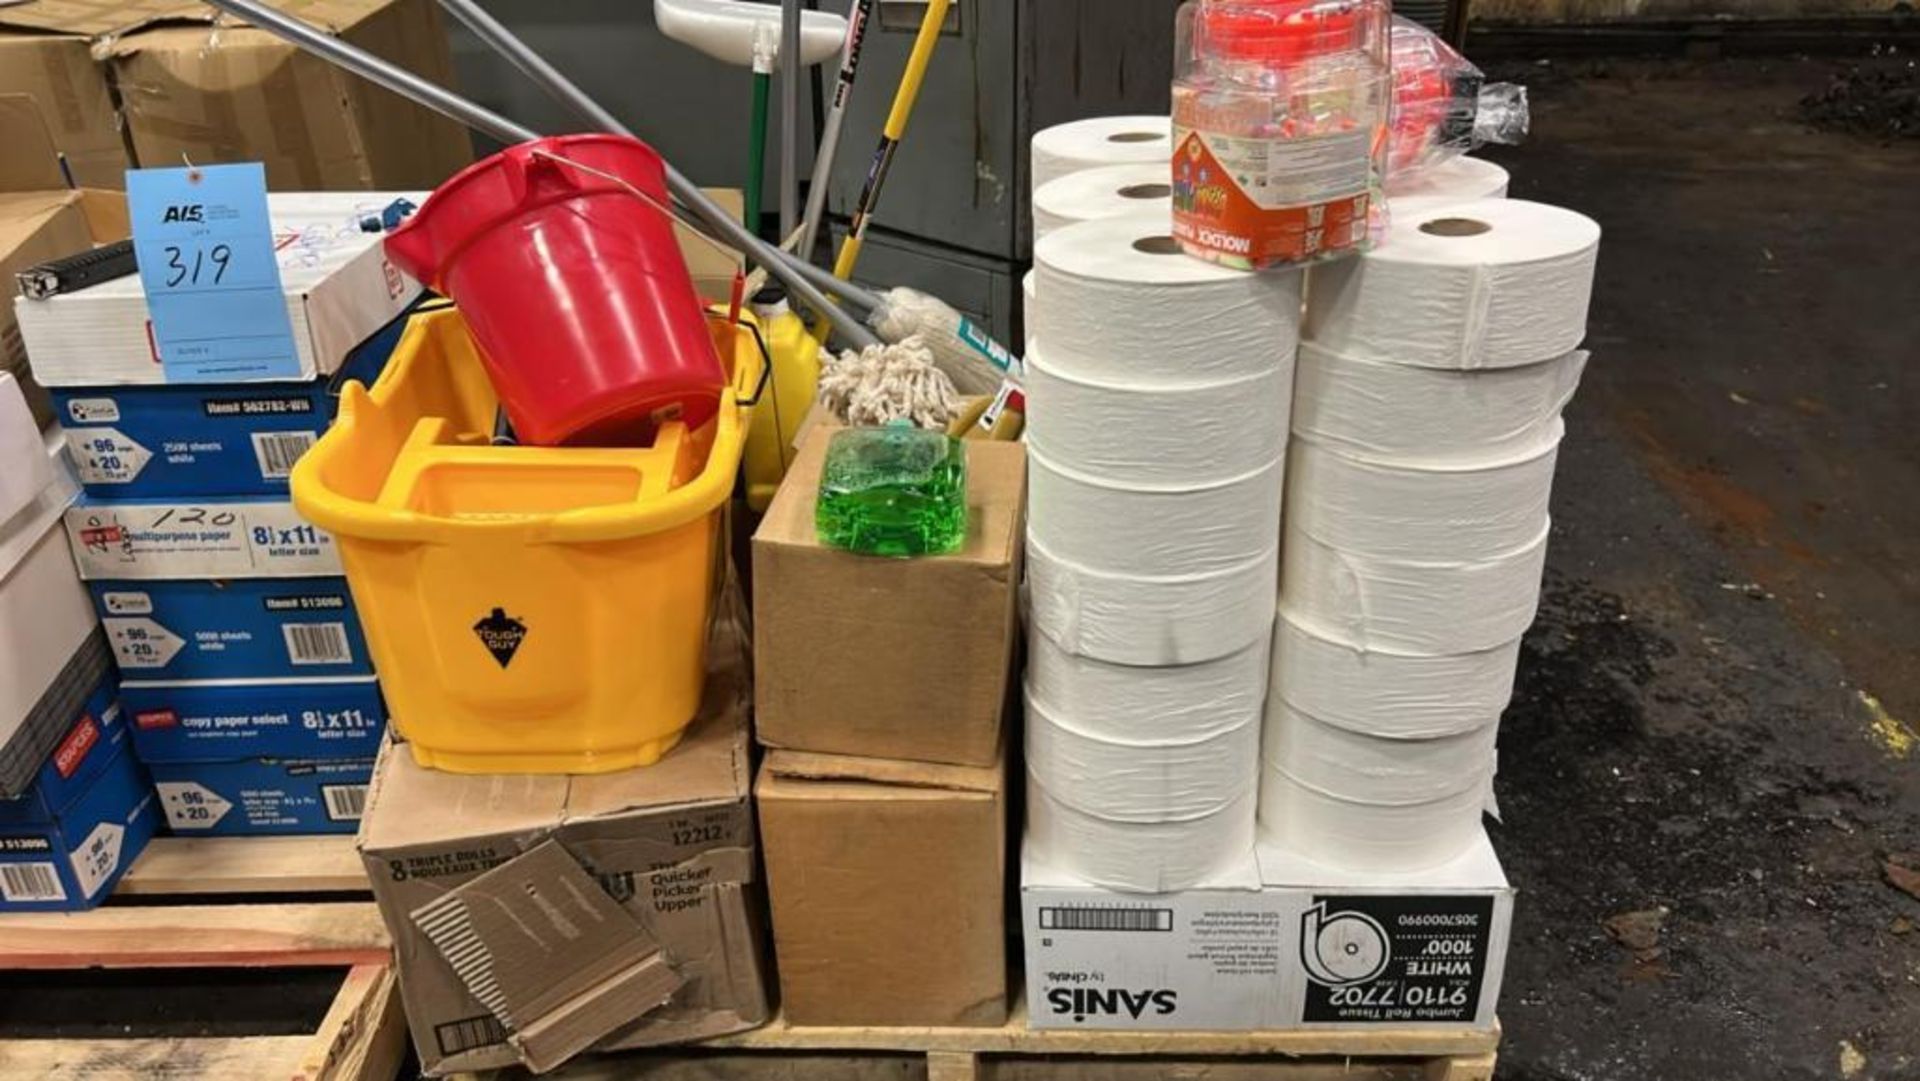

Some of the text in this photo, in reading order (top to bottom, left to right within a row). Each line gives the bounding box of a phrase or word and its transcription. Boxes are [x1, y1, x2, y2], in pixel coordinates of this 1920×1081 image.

[162, 203, 204, 223] AIS
[164, 243, 232, 288] 319
[93, 438, 115, 453] 96
[98, 455, 121, 469] 20
[488, 640, 515, 649] GUY
[181, 717, 211, 728] copy
[214, 715, 248, 727] paper
[252, 712, 288, 725] select
[186, 806, 209, 820] 20
[391, 859, 407, 881] 8
[651, 866, 713, 885] Quicker
[1405, 960, 1472, 976] WHITE
[1328, 985, 1469, 1006] 9110 7702
[1338, 1007, 1464, 1018] Jumbo Roll Tissue
